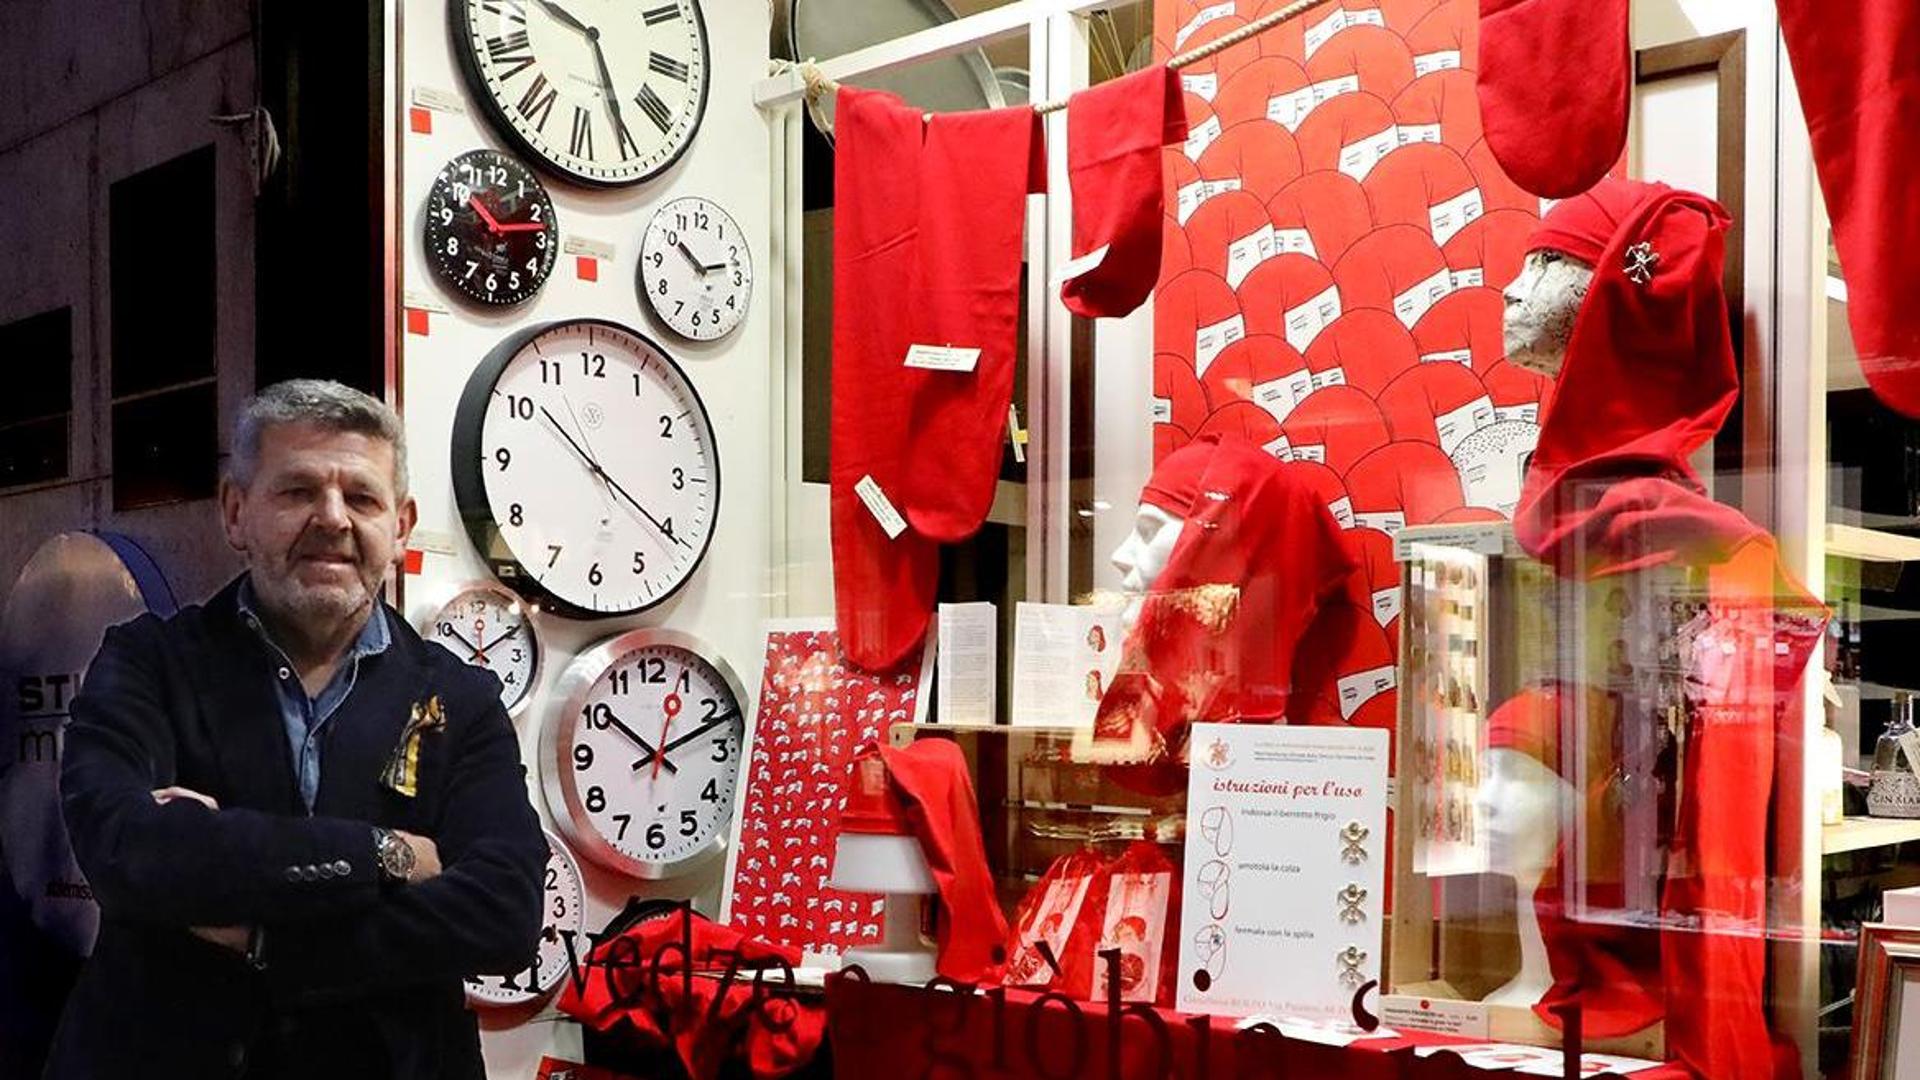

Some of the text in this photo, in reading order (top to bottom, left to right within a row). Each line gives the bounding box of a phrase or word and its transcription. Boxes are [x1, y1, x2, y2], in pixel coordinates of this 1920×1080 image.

[488, 166, 508, 187] 12
[517, 181, 525, 198] 1
[441, 208, 453, 226] 9
[530, 203, 542, 222] 2
[676, 213, 687, 231] 11
[694, 212, 708, 230] 12
[535, 232, 546, 249] 3
[718, 224, 724, 240] 1
[447, 237, 459, 256] 8
[729, 246, 740, 267] 2
[464, 260, 479, 279] 7
[526, 257, 538, 277] 4
[653, 252, 663, 268] 9
[486, 273, 498, 291] 6
[508, 272, 520, 289] 5
[658, 279, 668, 295] 8
[733, 270, 743, 287] 3
[675, 300, 684, 316] 7
[725, 295, 735, 310] 4
[691, 311, 701, 326] 6
[711, 309, 721, 324] 5
[539, 360, 562, 386] 11
[581, 353, 606, 379] 12
[632, 374, 641, 397] 1
[506, 395, 535, 421] 10
[659, 415, 673, 438] 2
[495, 448, 511, 471] 9
[671, 467, 684, 490] 3
[510, 504, 523, 526] 8
[659, 517, 674, 538] 4
[547, 545, 563, 568] 7
[632, 552, 645, 574] 5
[588, 563, 603, 586] 6
[436, 622, 452, 637] 10
[511, 649, 522, 663] 3
[504, 671, 516, 685] 4
[638, 658, 666, 683] 12
[680, 669, 690, 693] 1
[608, 670, 628, 694] 11
[582, 703, 611, 730] 10
[700, 698, 719, 724] 2
[573, 744, 594, 771] 9
[711, 739, 729, 762] 3
[700, 778, 719, 803] 4
[1213, 778, 1364, 799] istruzioni per l'uso
[586, 786, 606, 813] 8
[612, 815, 631, 840] 7
[679, 810, 698, 836] 5
[646, 824, 666, 849] 6
[545, 868, 558, 890] 2
[552, 896, 566, 918] 3
